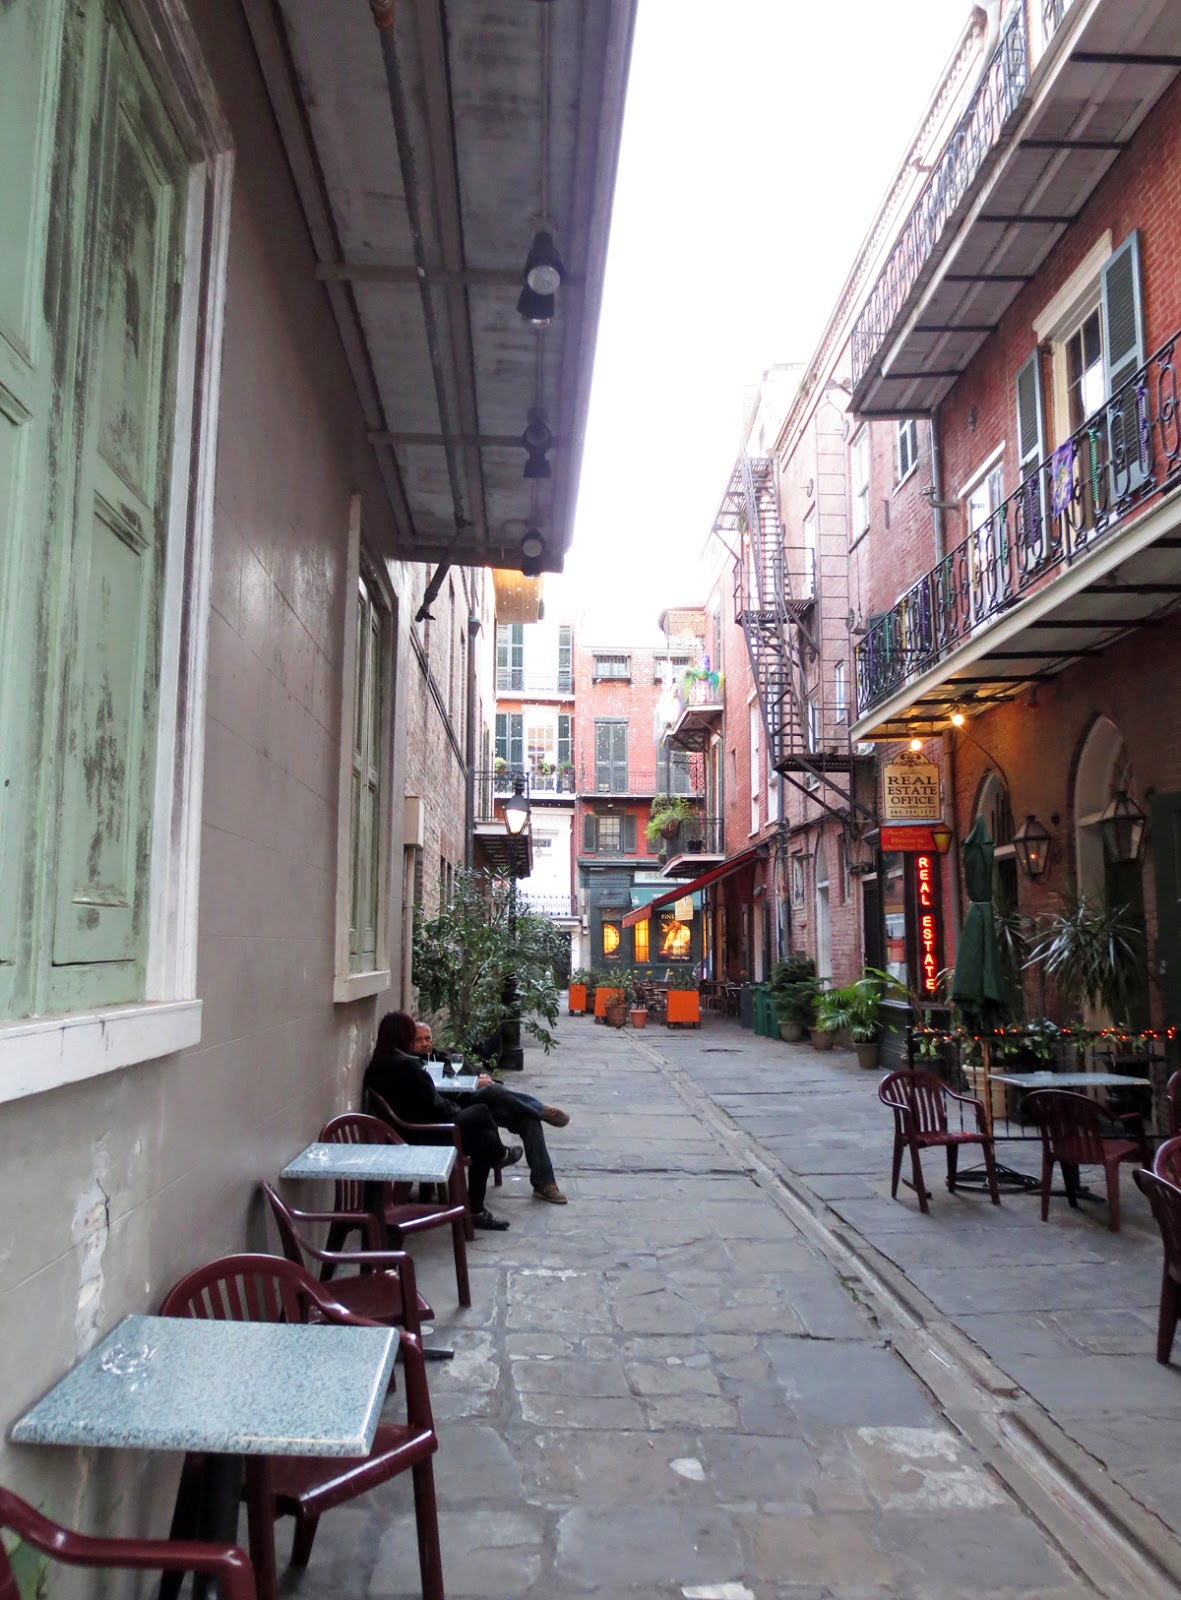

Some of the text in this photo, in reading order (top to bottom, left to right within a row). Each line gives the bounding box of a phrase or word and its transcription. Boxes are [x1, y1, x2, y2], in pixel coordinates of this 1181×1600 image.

[887, 776, 938, 785] REAL
[887, 786, 938, 795] ESTATE
[891, 796, 935, 805] OFFICE
[917, 856, 936, 990] REAL ESTATE
